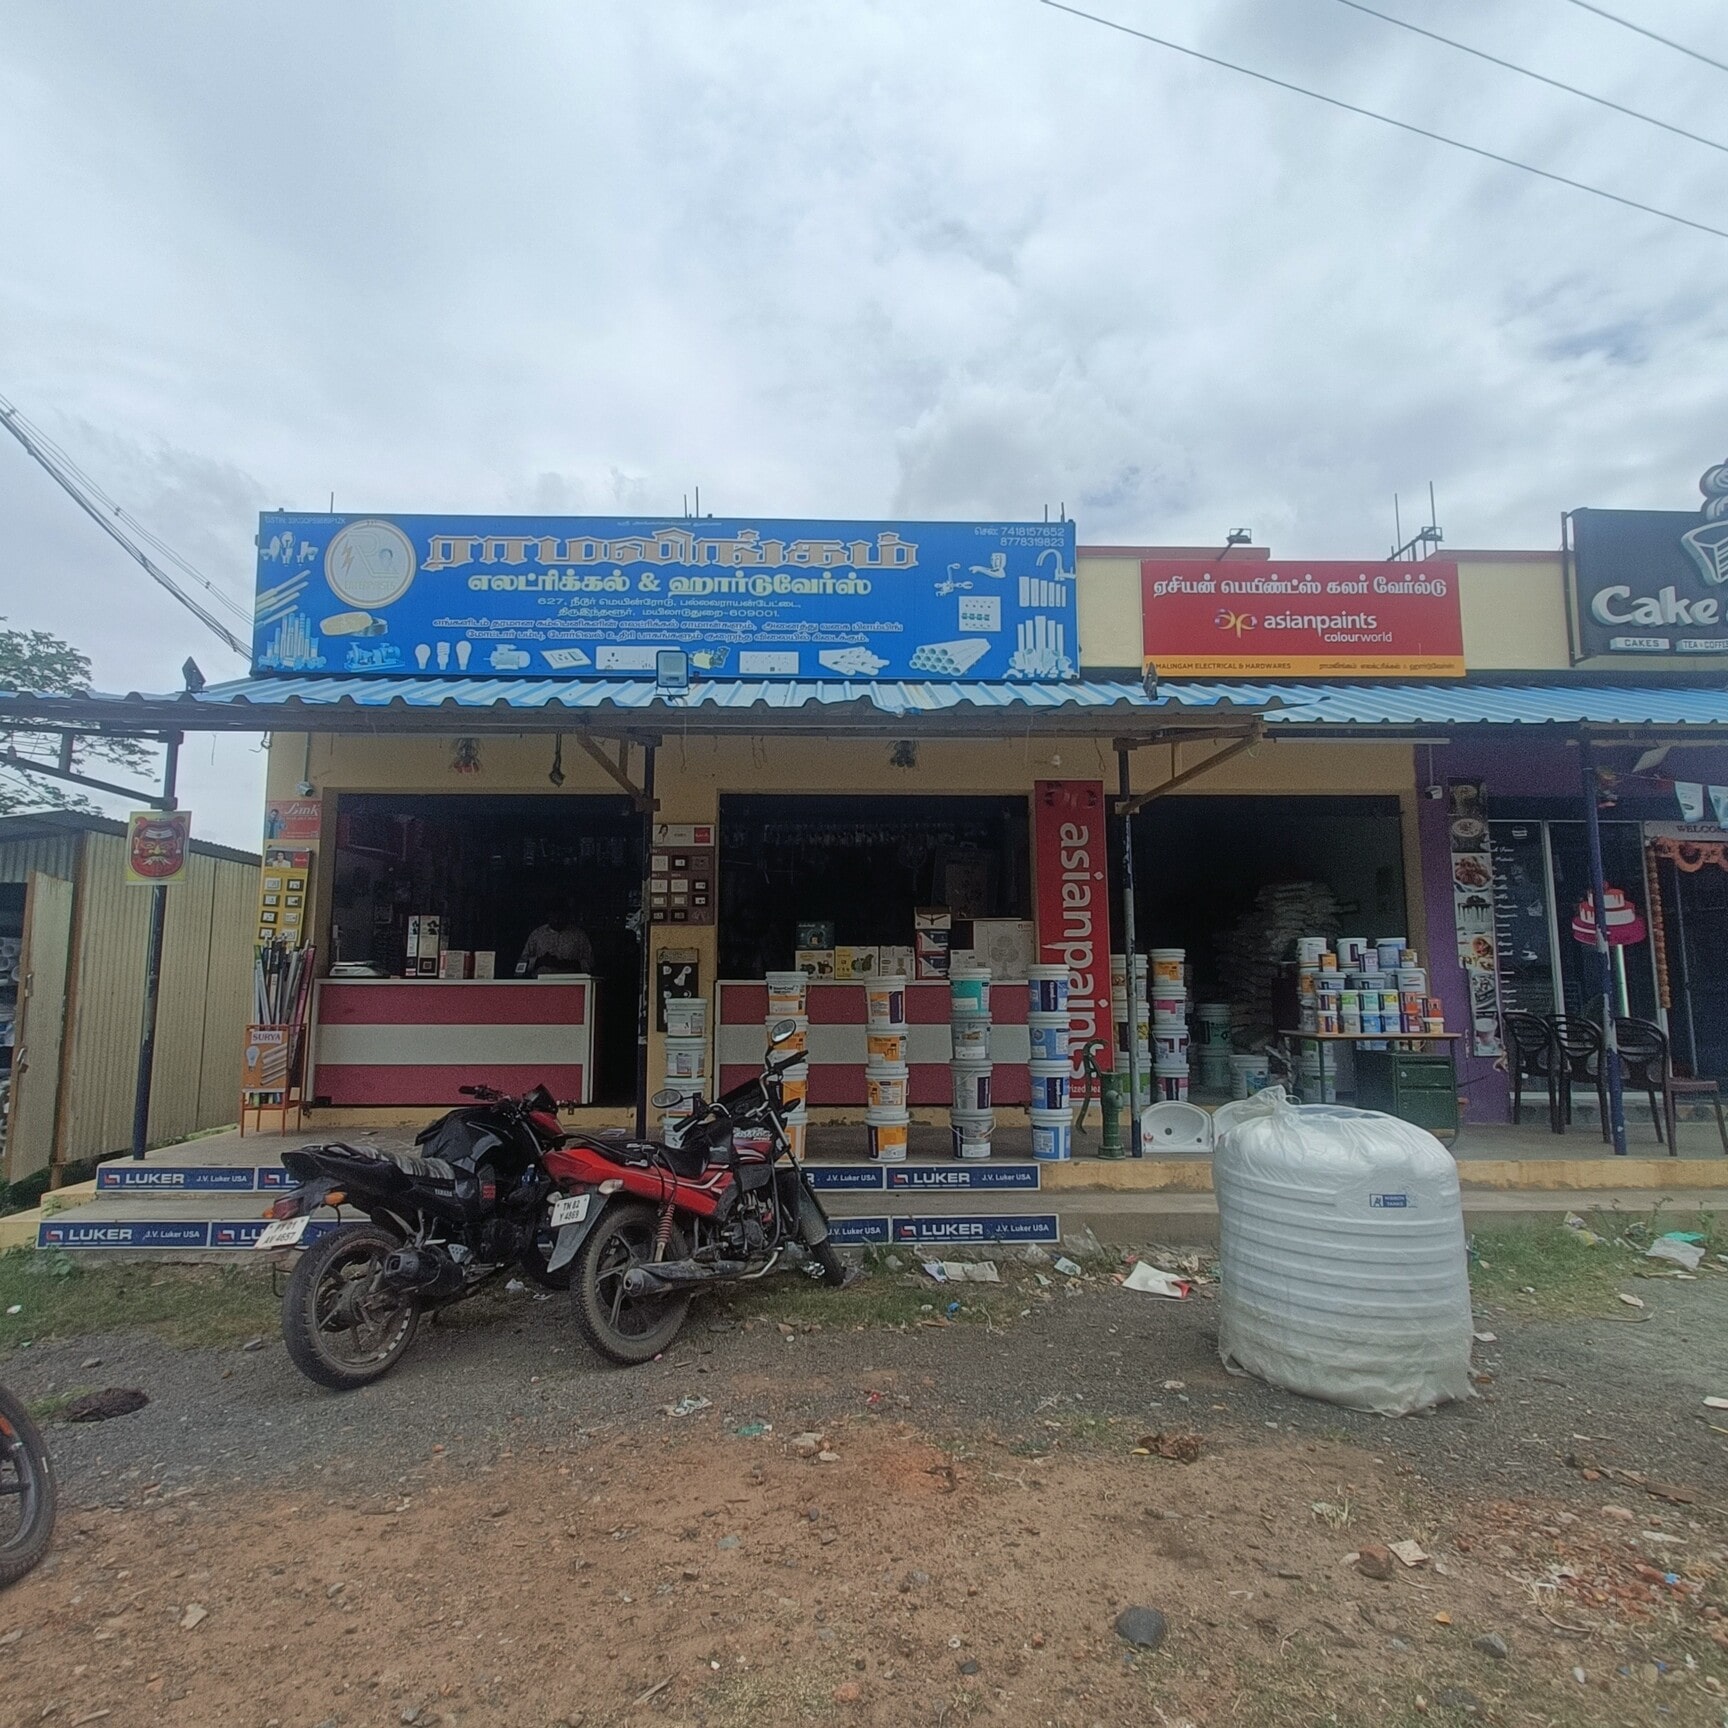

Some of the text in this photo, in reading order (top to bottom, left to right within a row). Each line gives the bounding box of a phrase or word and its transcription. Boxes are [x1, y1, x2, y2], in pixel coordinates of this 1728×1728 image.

[1000, 527, 1065, 537] 7418157652
[1000, 537, 1064, 547] 8778319823
[420, 527, 919, 572] ராமலிங்கம்
[468, 569, 872, 597] எலட்ரிக்கல் & ஹார்டுவேர்ஸ்
[1153, 573, 1447, 599] ஏசியன் பெயிண்ட்ஸ் கலர் வேர்ல்டு
[1591, 585, 1720, 627] Cake
[1263, 611, 1378, 637] asianpaints
[1324, 631, 1392, 643] colourworld
[1624, 639, 1660, 648] CAKES
[1682, 640, 1698, 649] TEA
[1146, 662, 1193, 671] MALINGAM
[1194, 662, 1238, 670] ELECTRICAL
[1245, 662, 1292, 670] HARDWARES
[252, 1032, 281, 1042] SURYA
[125, 1173, 247, 1185] LUKER J.V. Luker USA
[826, 1174, 877, 1183] J.V. Luker USA
[913, 1172, 1031, 1184] LUKER J.V. Luker USA
[563, 1202, 572, 1211] TN
[68, 1229, 200, 1241] LUKER J.V. Luker USA
[828, 1226, 881, 1236] J.V. Luker USA
[922, 1223, 1050, 1236] LUKER J.V. Luker USA
